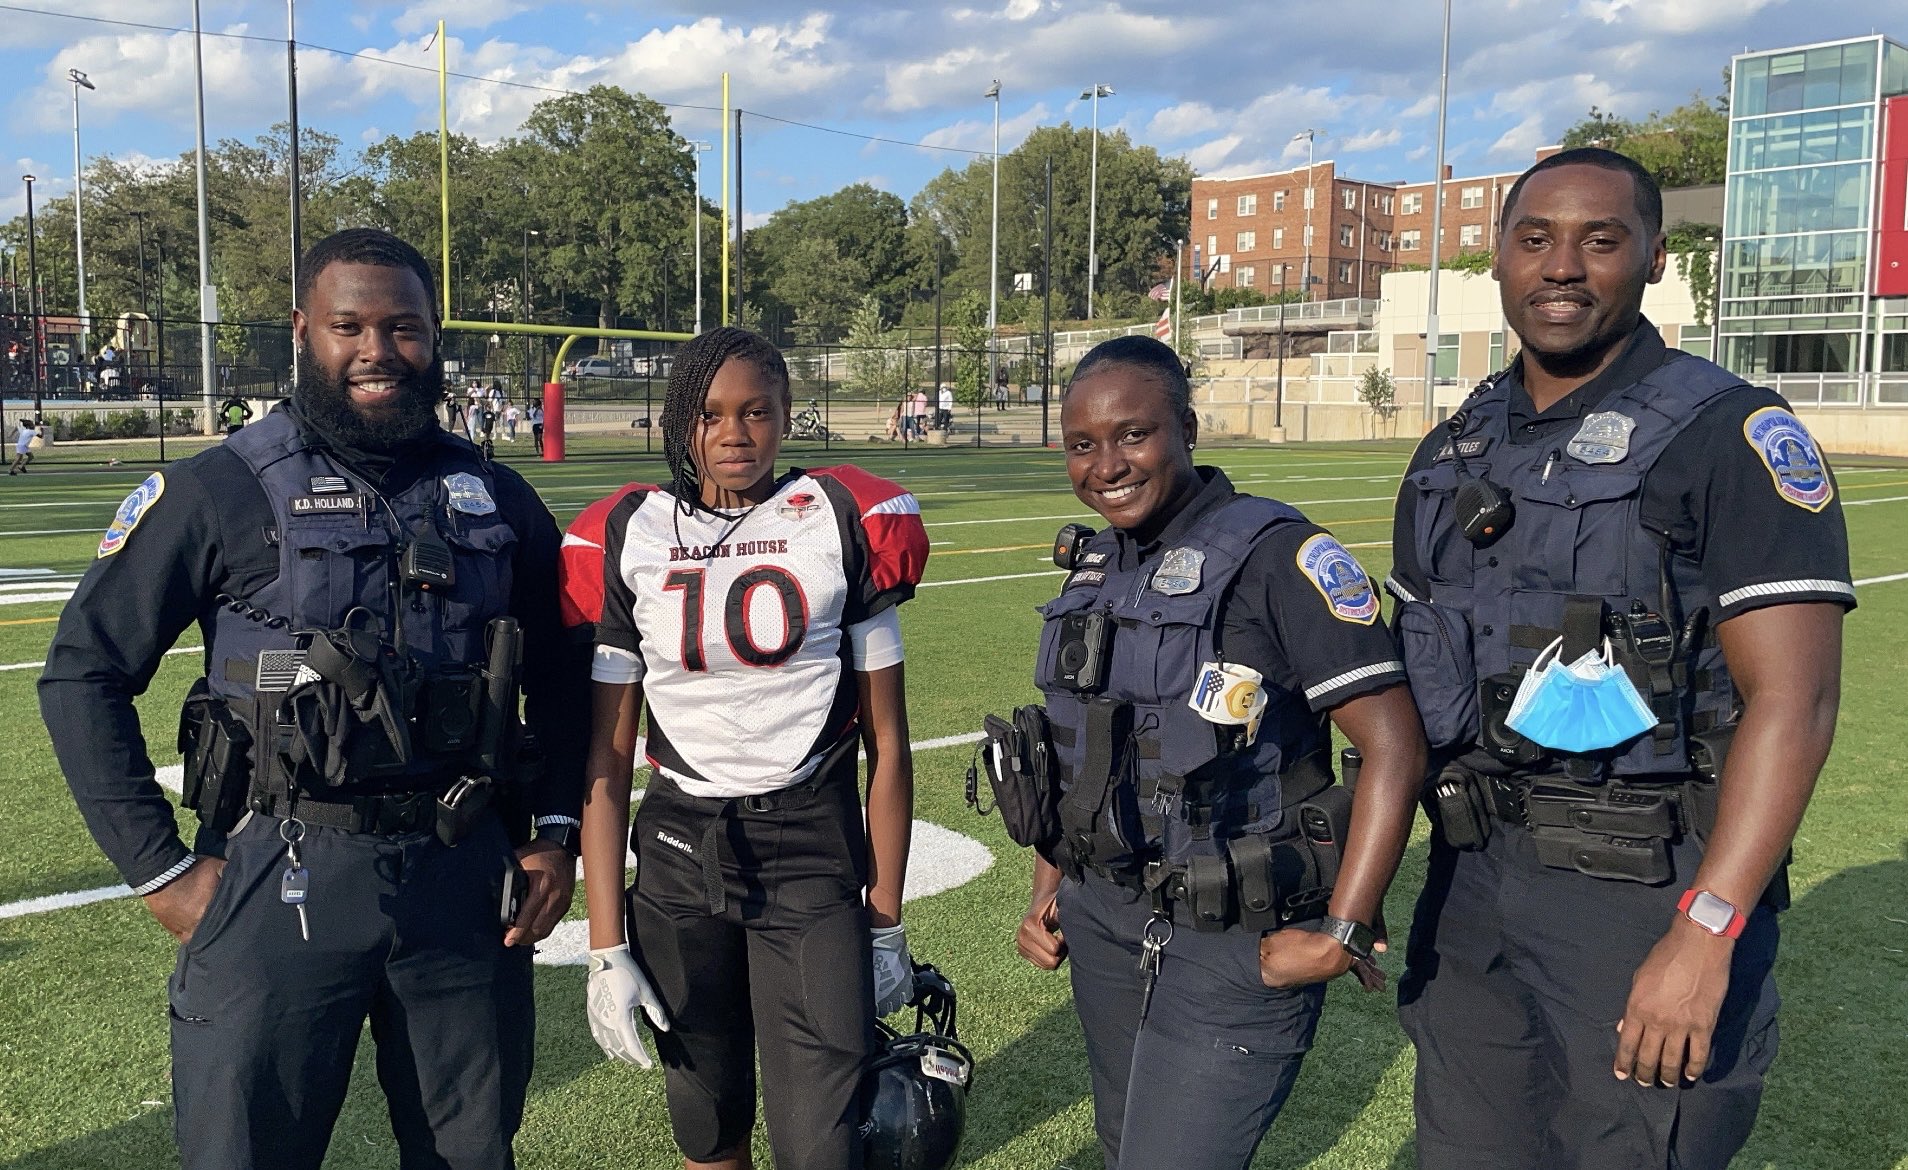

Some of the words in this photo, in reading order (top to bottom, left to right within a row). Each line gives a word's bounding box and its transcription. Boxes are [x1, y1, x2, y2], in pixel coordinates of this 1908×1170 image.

[294, 499, 313, 511] K.D.
[314, 498, 354, 509] HOLLAND
[669, 543, 731, 561] BEACON
[736, 539, 788, 556] HOUSE
[662, 565, 810, 672] 10
[299, 664, 322, 681] adida
